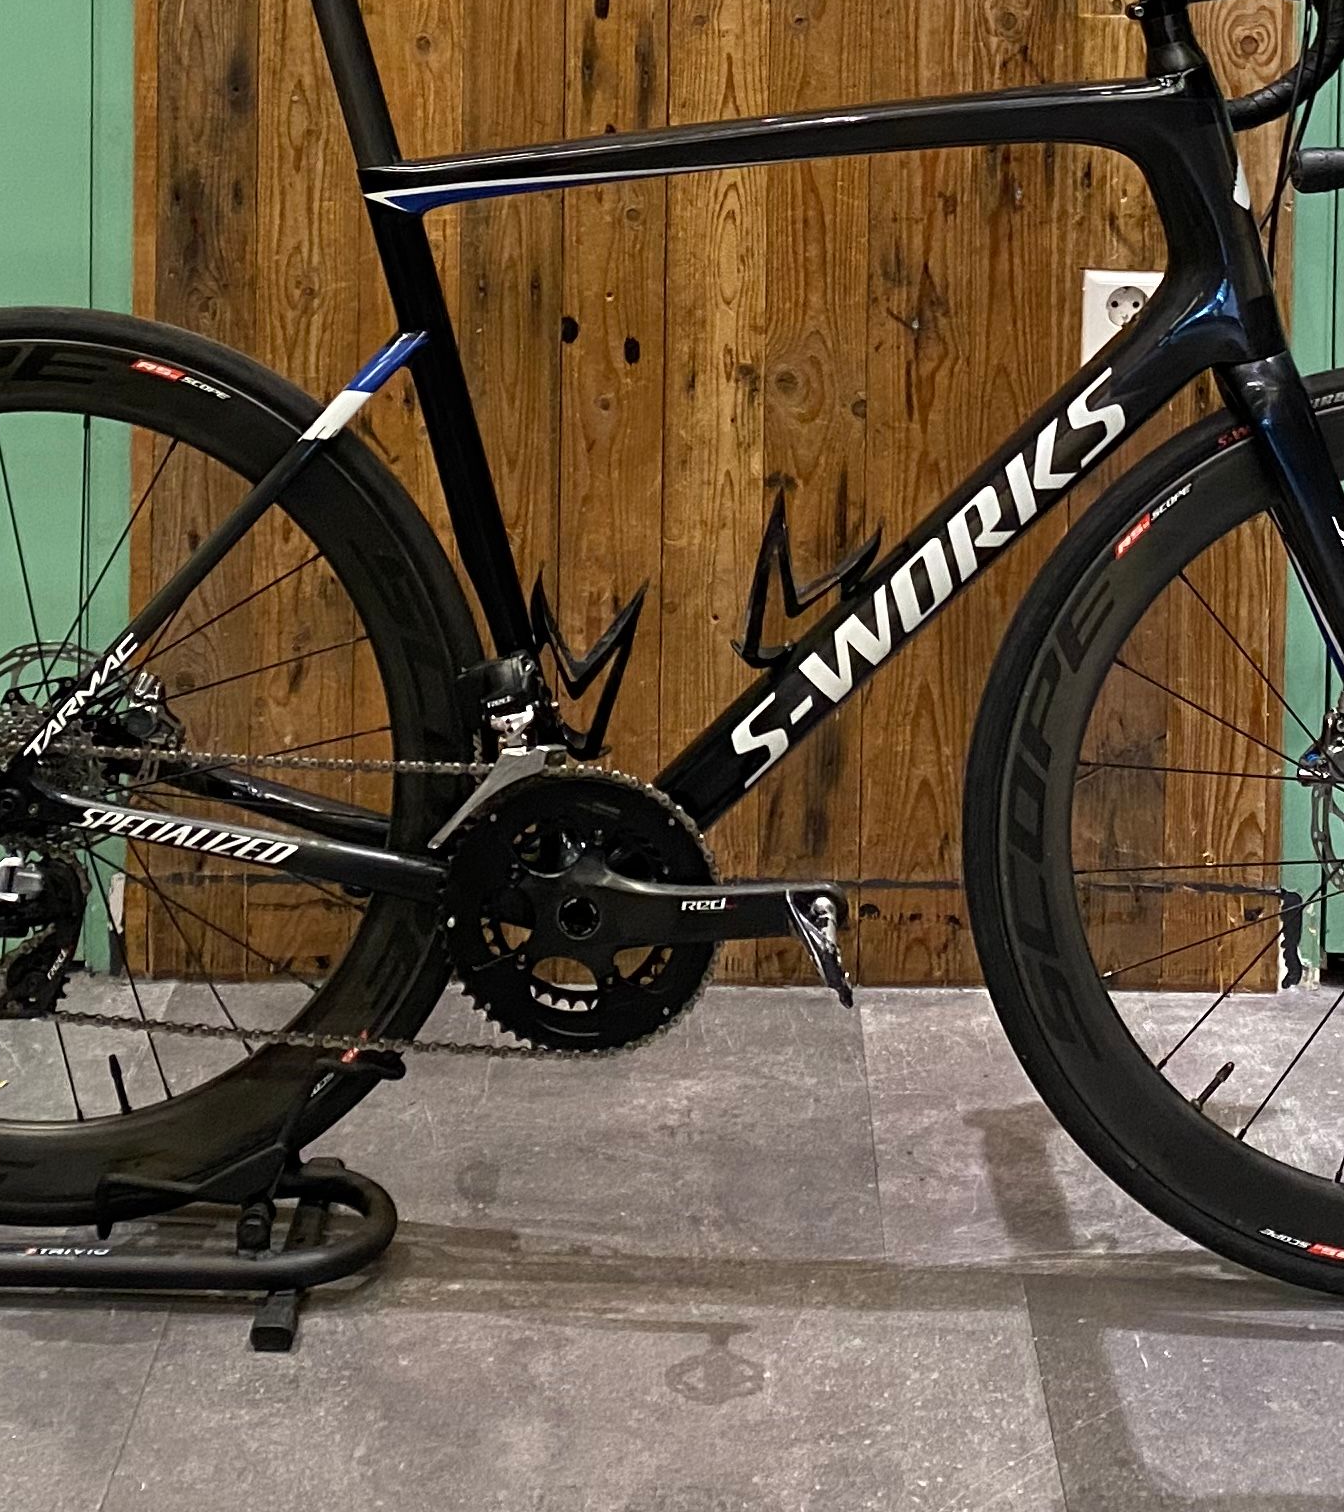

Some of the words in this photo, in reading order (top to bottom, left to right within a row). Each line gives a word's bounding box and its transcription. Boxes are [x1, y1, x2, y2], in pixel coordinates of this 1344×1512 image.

[179, 376, 232, 400] SCOPE
[730, 365, 1128, 789] S-WORKS
[23, 632, 139, 759] TARMAC
[69, 807, 299, 864] SPECIALIZED
[1004, 573, 1118, 1065] SCOPE
